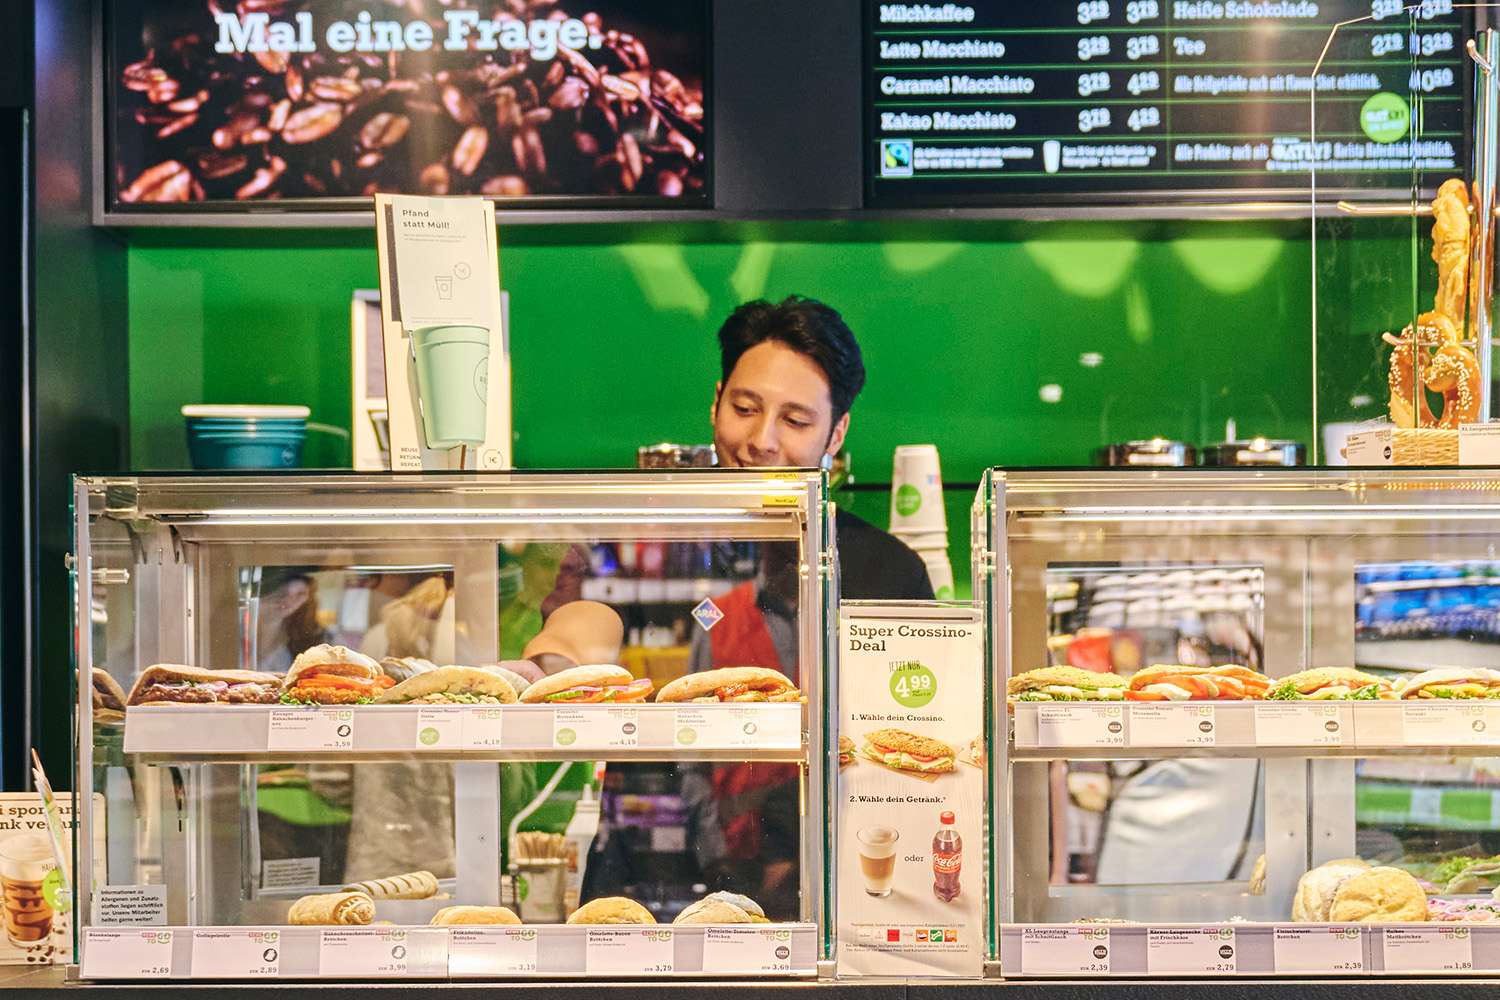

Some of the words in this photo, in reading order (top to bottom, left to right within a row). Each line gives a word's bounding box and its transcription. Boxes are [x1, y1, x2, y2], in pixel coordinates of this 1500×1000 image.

[880, 5, 975, 22] Milchkaffee
[1173, 2, 1223, 19] Heiße
[1225, 1, 1319, 18] Schokolade
[214, 12, 316, 53] Mal
[326, 11, 433, 51] eine
[443, 10, 602, 61] Frage.
[880, 41, 921, 58] Latte
[922, 40, 1005, 58] Macchiato
[1173, 37, 1206, 55] Tee
[881, 76, 950, 94] Caramel
[952, 75, 1034, 94] Macchiato
[881, 112, 931, 130] Kakao
[932, 111, 1015, 130] Macchiato
[402, 209, 430, 218] Pfand
[402, 221, 425, 229] statt
[427, 221, 451, 230] Müll!
[850, 625, 895, 640] Super
[898, 625, 972, 638] Crossino-
[850, 640, 886, 651] Deal
[889, 660, 906, 673] JETZT
[907, 659, 920, 671] NUR
[860, 713, 885, 721] Wähle
[886, 713, 905, 721] dein
[906, 713, 945, 722] Crossino.
[859, 795, 885, 803] Wähle
[886, 795, 904, 803] dein
[904, 854, 924, 862] oder
[1090, 963, 1108, 972] 2,39
[1344, 962, 1362, 970] 2,39
[1454, 962, 1472, 970] 1,89
